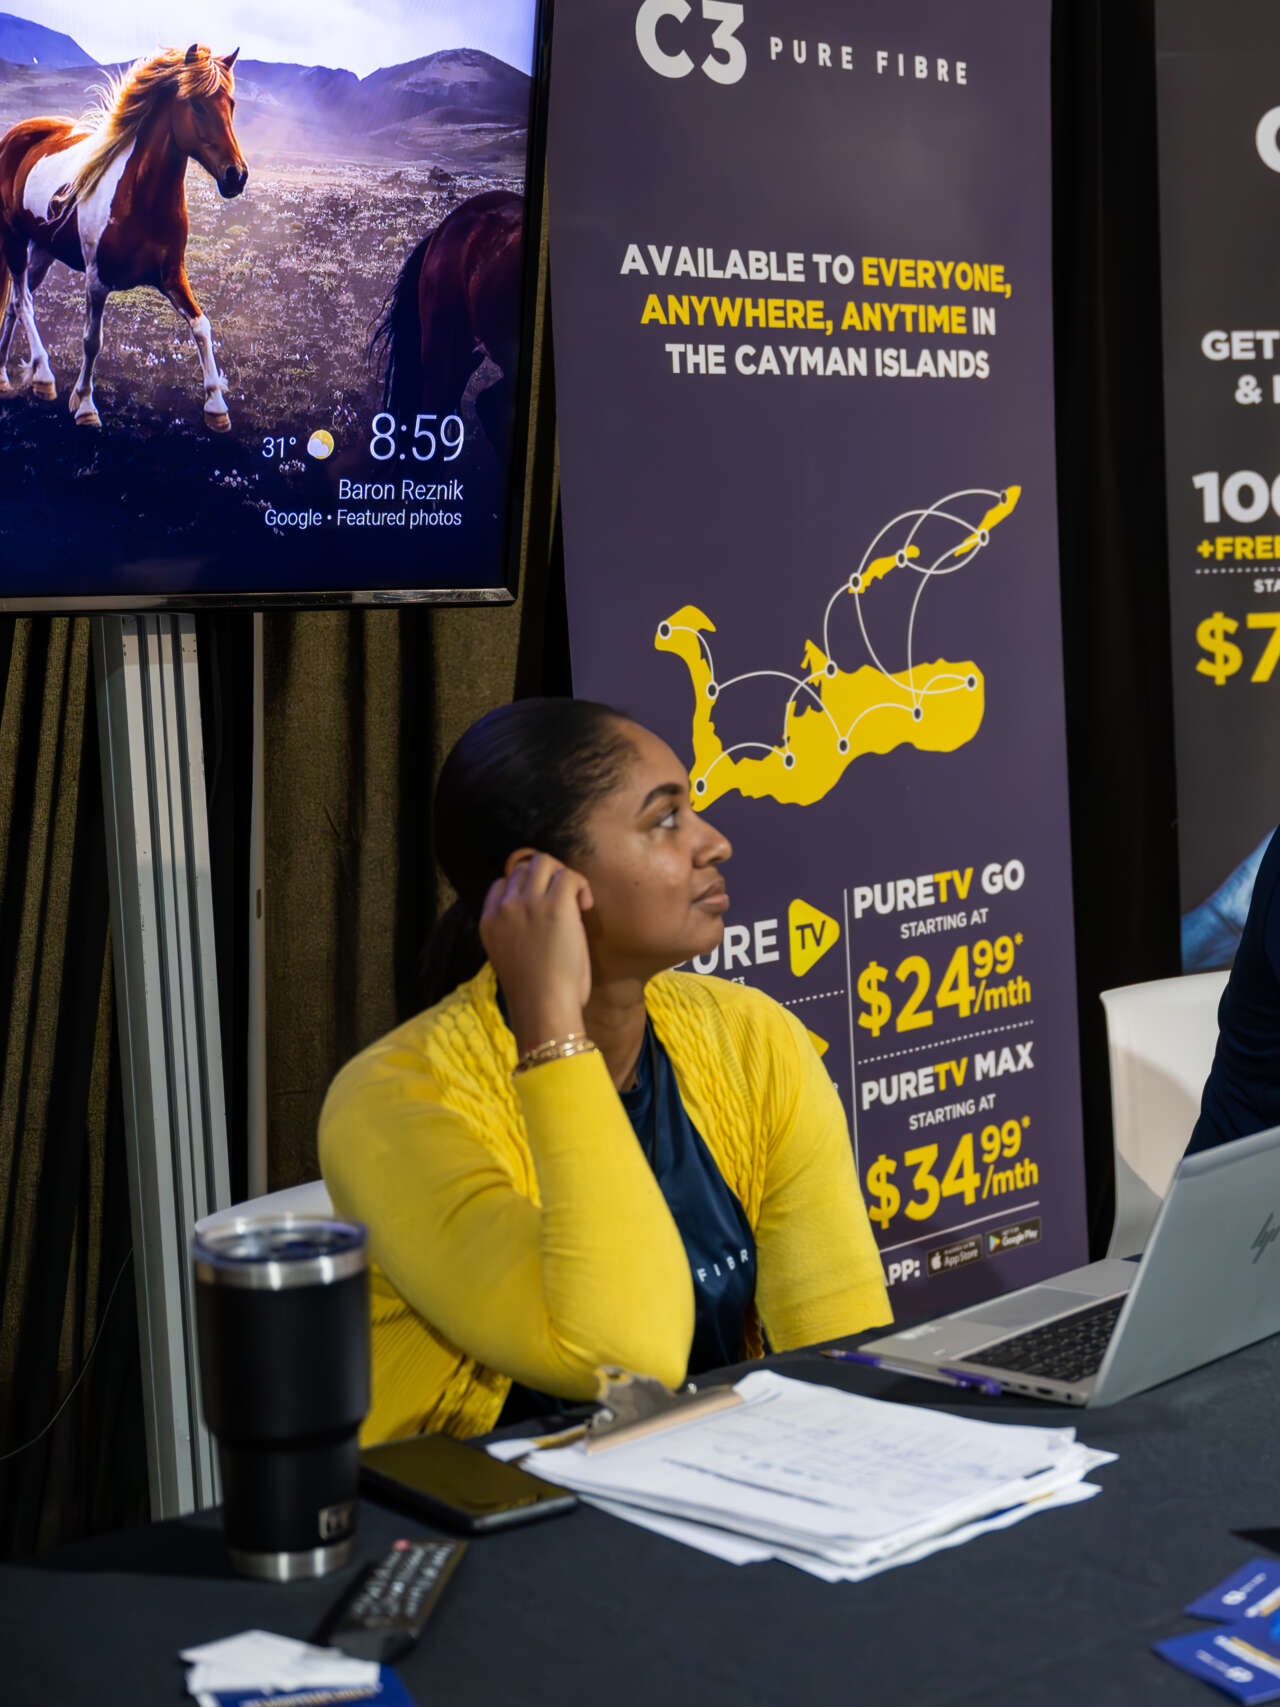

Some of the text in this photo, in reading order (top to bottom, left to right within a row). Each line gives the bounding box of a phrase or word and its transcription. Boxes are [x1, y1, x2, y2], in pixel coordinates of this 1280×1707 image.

[636, 0, 967, 85] C3 PURE FIBRE
[620, 244, 1011, 299] AVAILABLE TO EVERYONE,
[640, 294, 996, 335] ANYWHERE, ANYTIME IN
[665, 343, 990, 379] THE CAYMAN ISLANDS
[1201, 330, 1280, 360] GET
[1235, 374, 1262, 404] &
[262, 412, 465, 462] 31° 8:59
[339, 479, 464, 500] Baron Reznik
[264, 508, 462, 529] Google Featured photos
[854, 859, 1026, 918] PURETV GO
[900, 908, 989, 939] STARTING AT
[668, 919, 826, 975] URE TV
[862, 1042, 1034, 1110] PURETV MAX
[909, 1094, 996, 1131] STARTING AT
[884, 1258, 920, 1287] PP:
